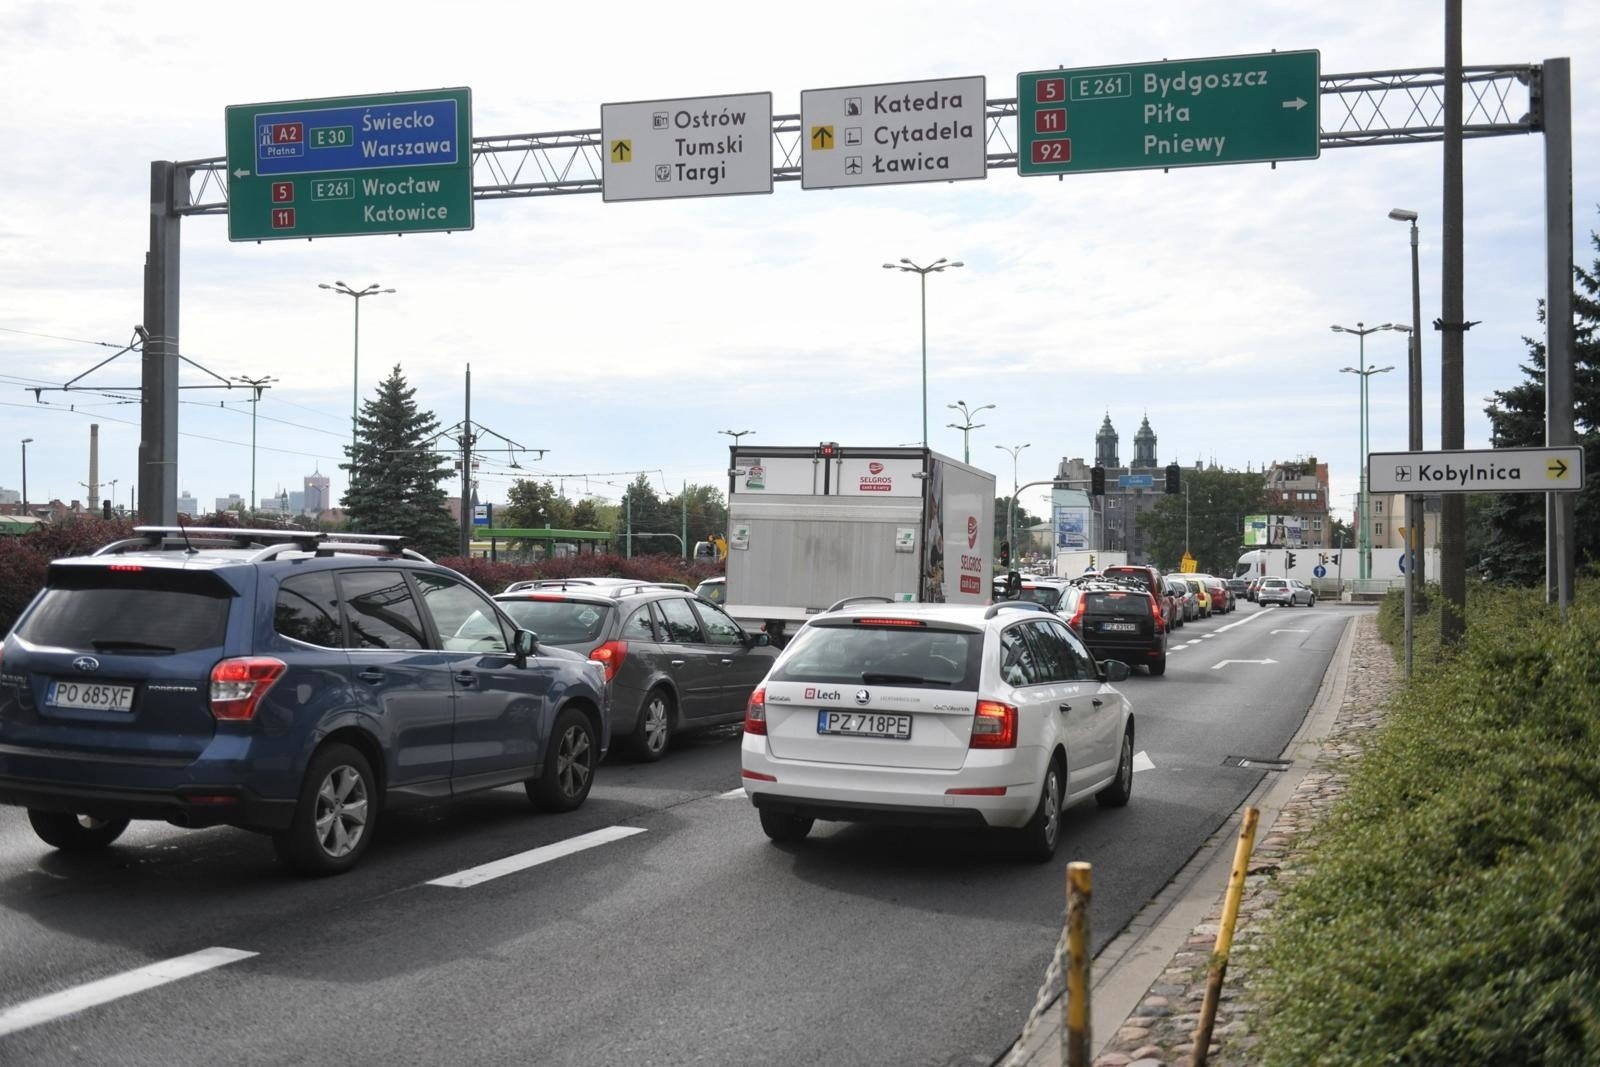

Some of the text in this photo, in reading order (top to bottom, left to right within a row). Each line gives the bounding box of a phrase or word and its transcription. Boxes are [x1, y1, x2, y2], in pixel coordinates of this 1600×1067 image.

[1046, 71, 1268, 98] 5 E 261 Bydgoszcz
[873, 91, 963, 115] Katedra
[674, 108, 747, 130] Ostrów
[1043, 103, 1191, 128] 11 Piła
[279, 109, 435, 145] A2 E 30 Świecko
[873, 121, 974, 149] Cytadela
[267, 146, 296, 157] Płatna
[361, 139, 451, 158] Warszawa
[675, 135, 744, 157] Tumski
[1040, 133, 1226, 160] 92 Pniewy
[675, 161, 726, 185] Targi
[872, 152, 949, 173] Ławica
[279, 177, 441, 199] 5 E 261 Wrocław
[278, 203, 448, 225] 11 Katowice
[1418, 463, 1521, 486] Kobylnica
[961, 554, 982, 573] SELGROS
[57, 683, 132, 706] PO 685XF
[817, 690, 841, 700] Lech
[828, 713, 908, 734] PZ 718PE
